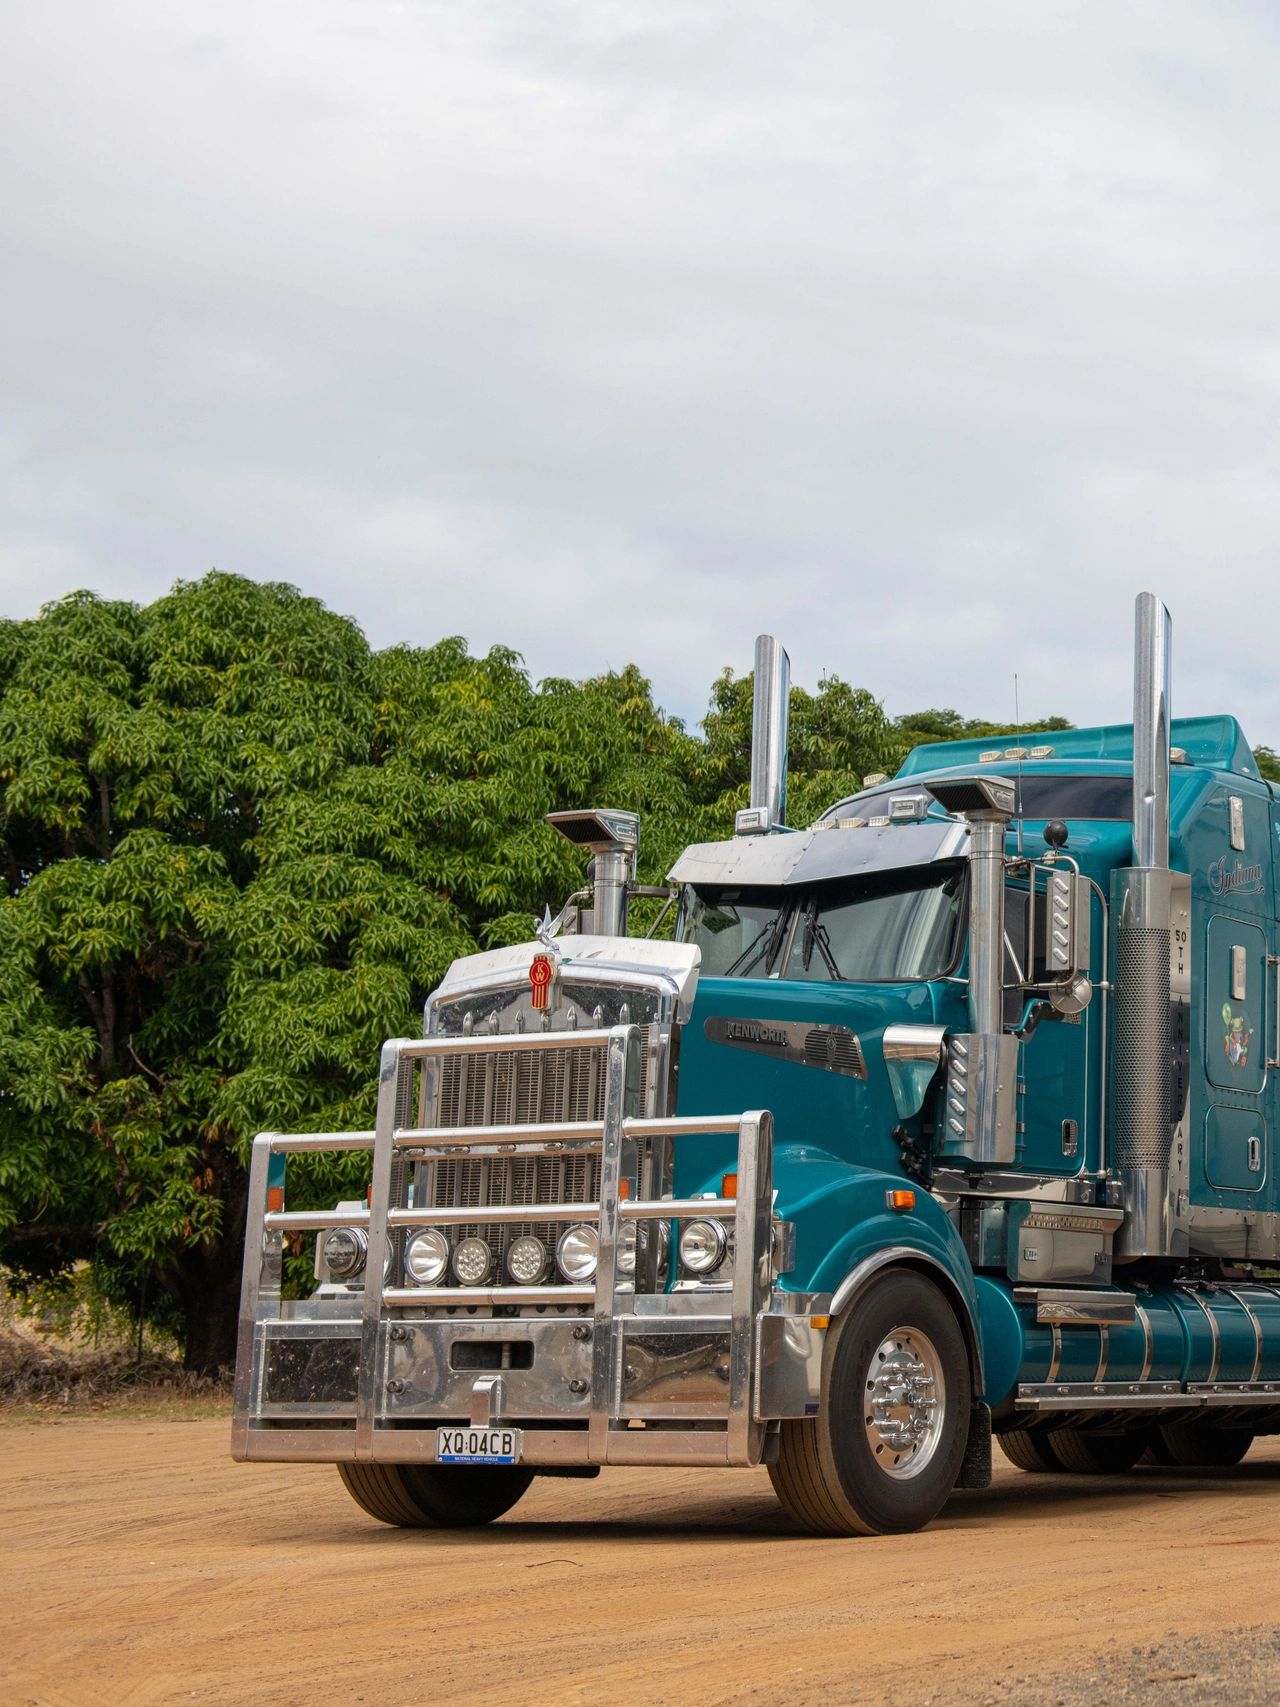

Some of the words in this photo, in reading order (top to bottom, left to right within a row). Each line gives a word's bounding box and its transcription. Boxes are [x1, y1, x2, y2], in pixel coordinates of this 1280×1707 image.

[1208, 855, 1263, 896] Indiana
[727, 1021, 788, 1043] KENWORTH
[1177, 994, 1185, 1171] ANNIVERSARY
